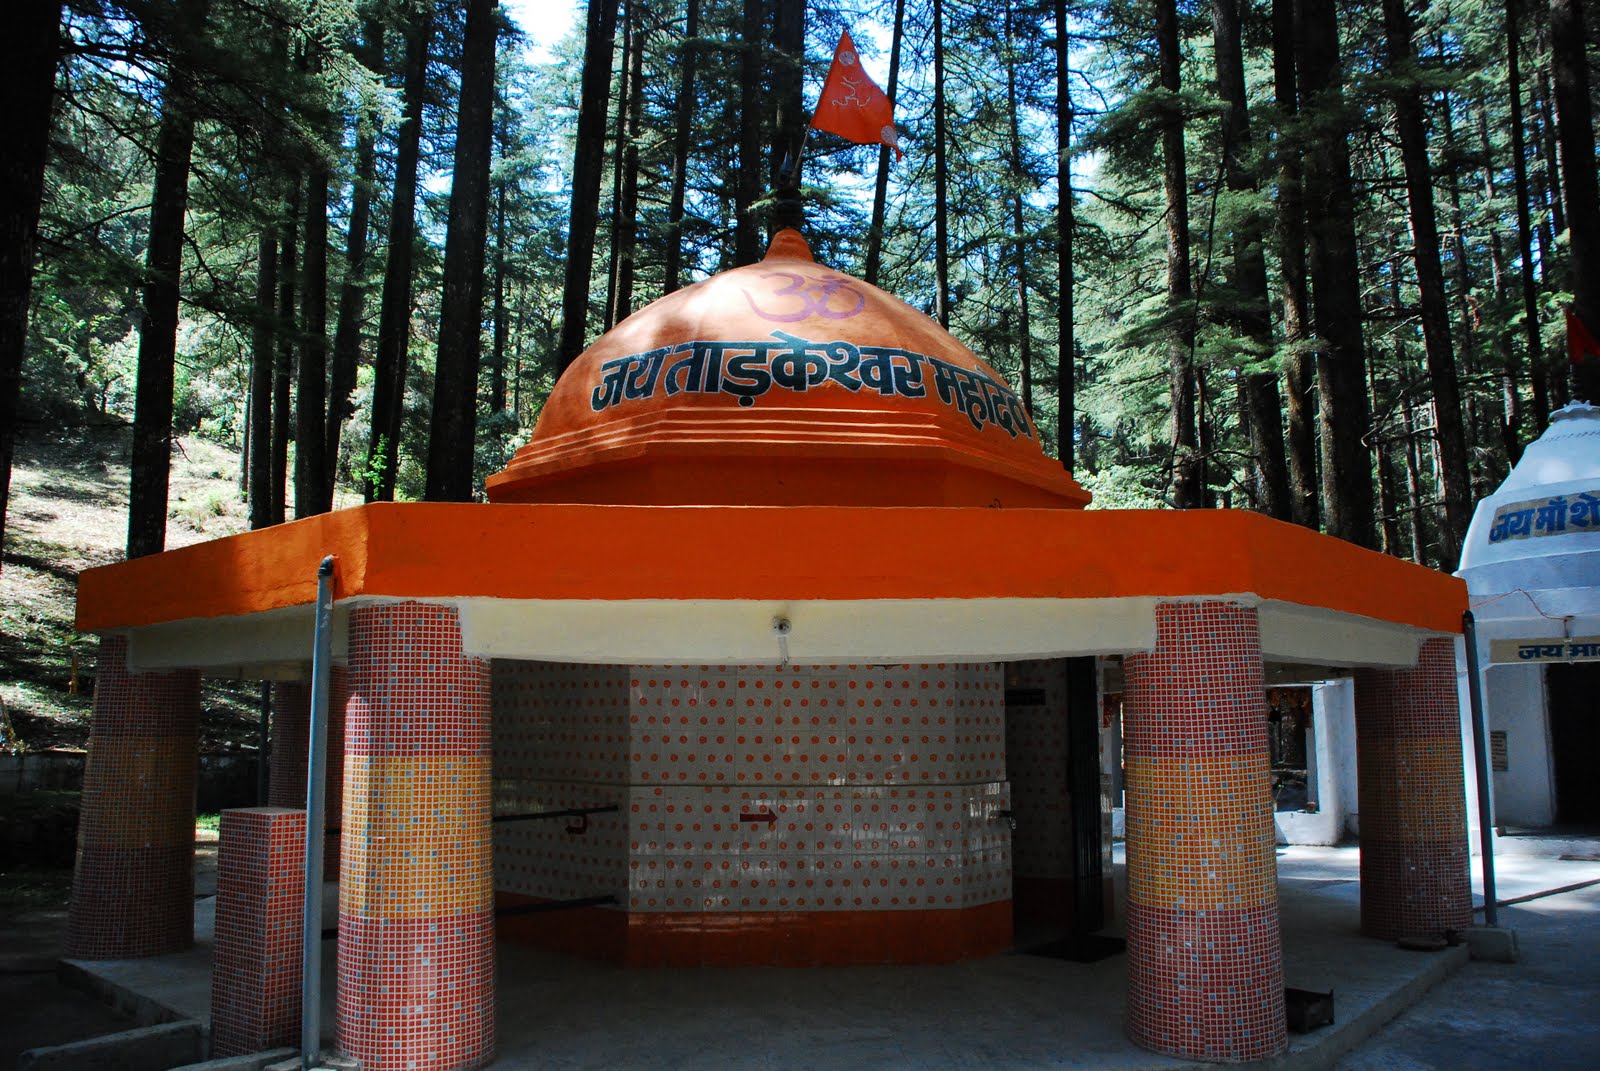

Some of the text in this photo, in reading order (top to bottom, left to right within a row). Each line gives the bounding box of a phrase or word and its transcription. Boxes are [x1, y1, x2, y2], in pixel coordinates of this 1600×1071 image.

[591, 345, 674, 412] जय
[666, 330, 928, 408] ताड़केश्वर
[1489, 508, 1537, 542] जय
[1518, 643, 1600, 660] जय मा
